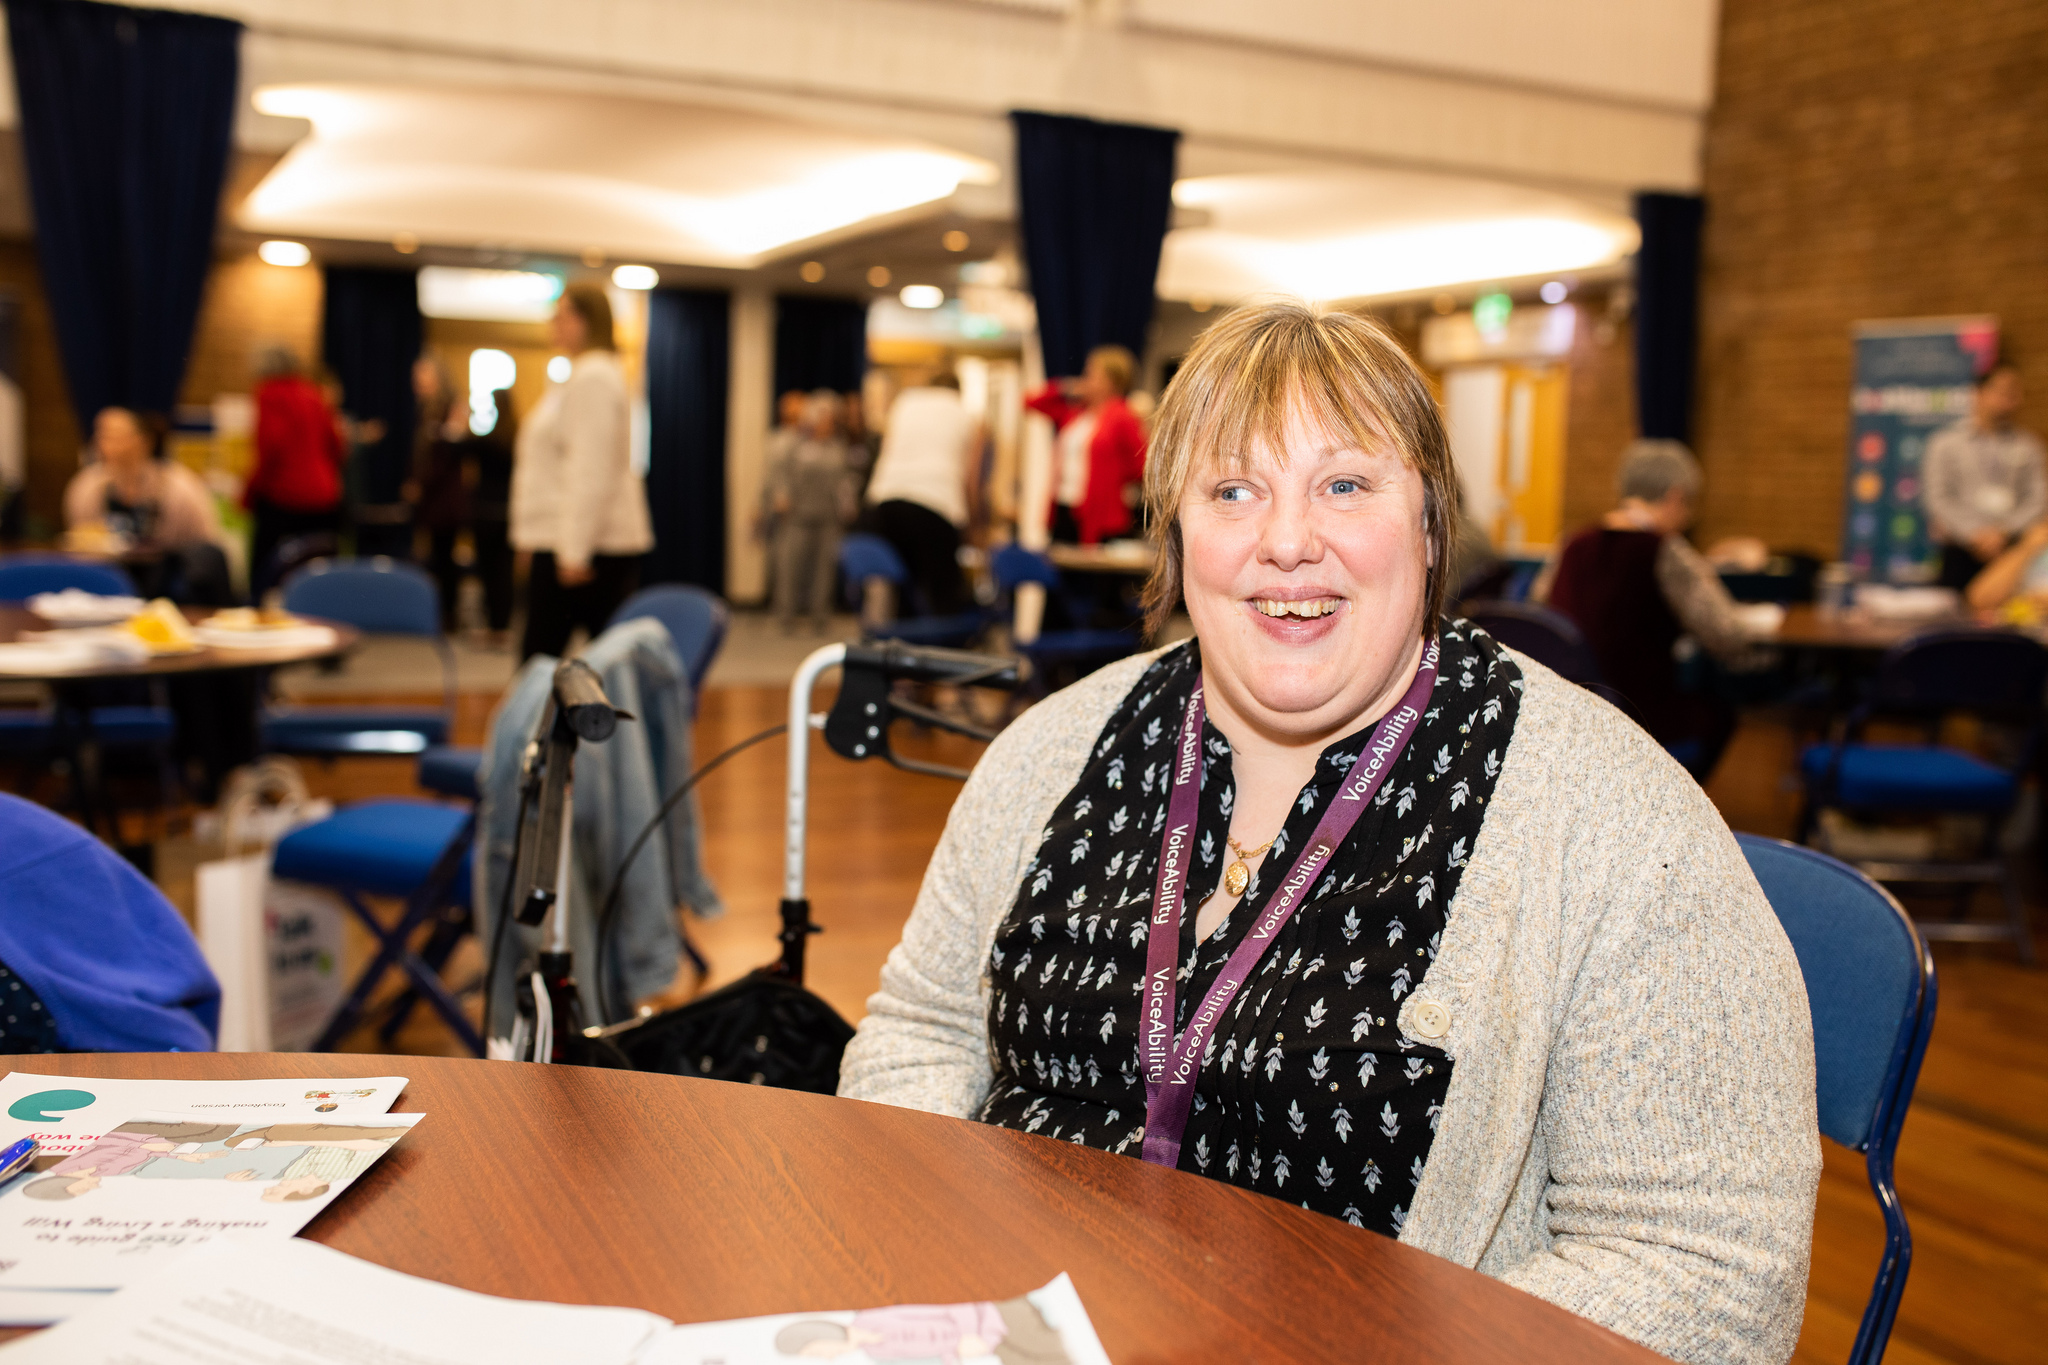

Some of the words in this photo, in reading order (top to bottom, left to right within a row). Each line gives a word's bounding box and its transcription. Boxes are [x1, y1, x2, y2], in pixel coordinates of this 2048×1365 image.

[1175, 687, 1204, 785] VoiceAbility
[1342, 704, 1418, 802] VoiceAbility
[1153, 823, 1189, 924] VoiceAbility
[1252, 844, 1330, 940] VoiceAbility
[1146, 966, 1171, 1083] VoiceAbility
[1170, 979, 1238, 1084] VoiceAbility
[22, 1217, 74, 1229] Will
[36, 1233, 60, 1242] to
[66, 1232, 138, 1245] guide
[81, 1217, 153, 1231] Living
[180, 1218, 269, 1231] making
